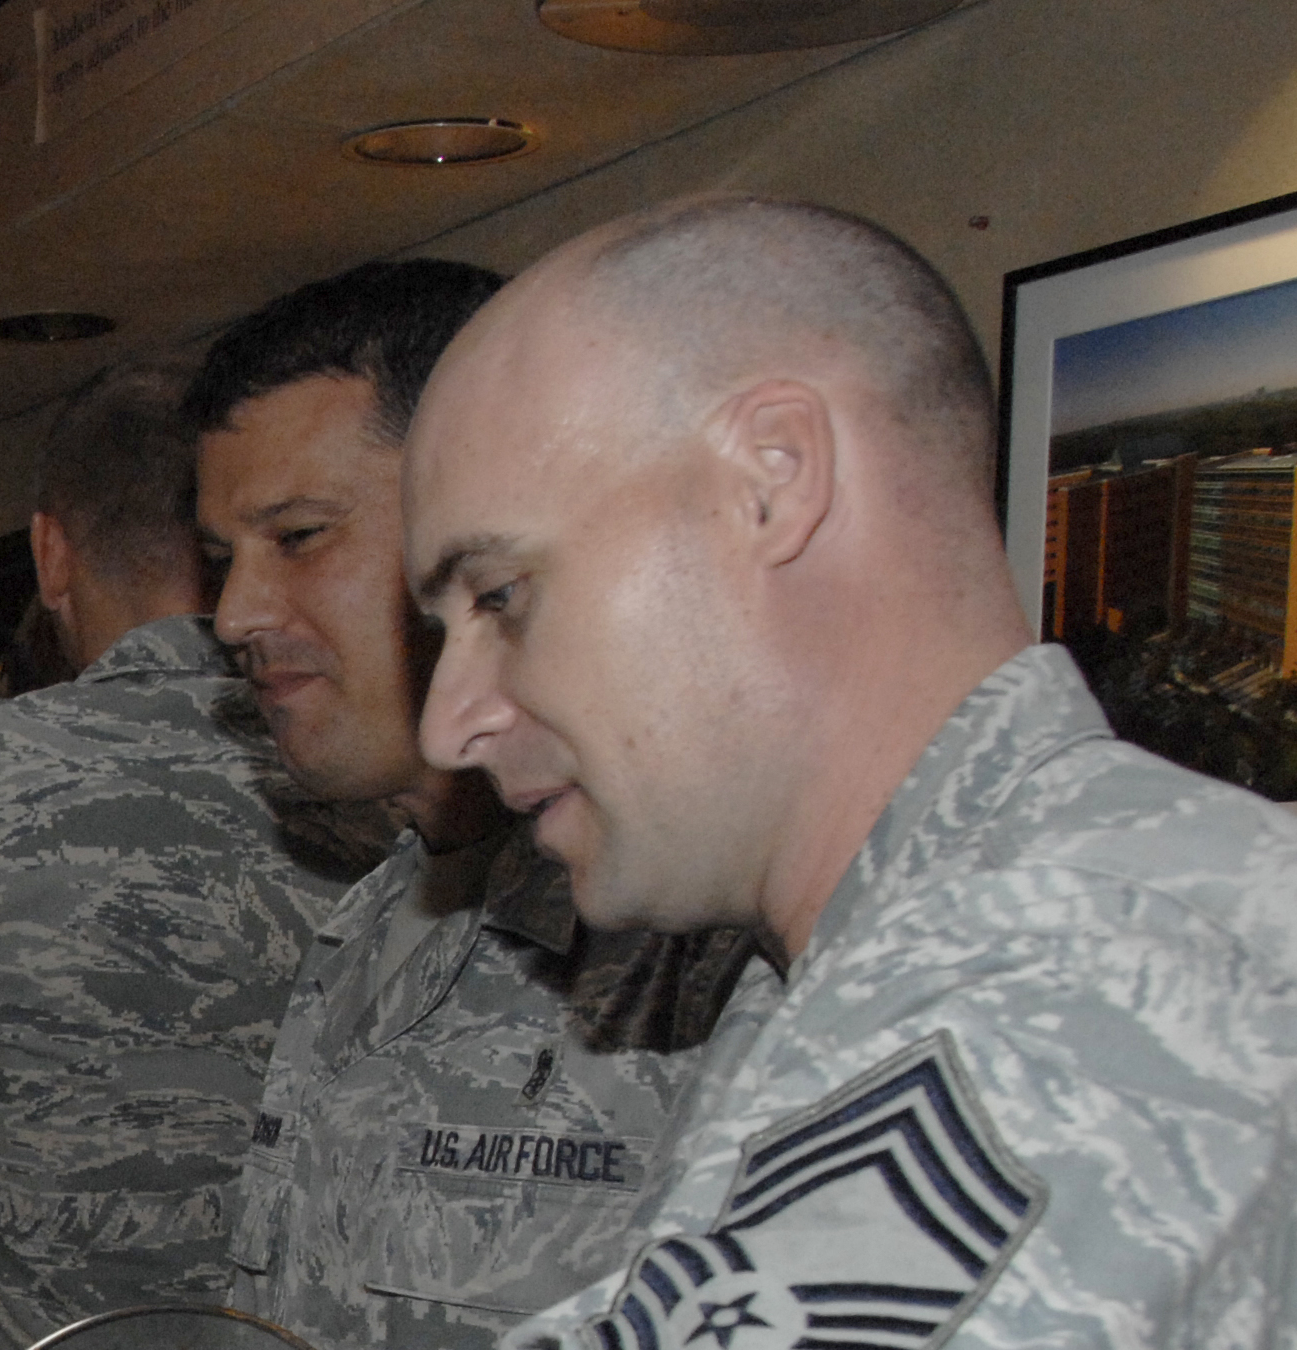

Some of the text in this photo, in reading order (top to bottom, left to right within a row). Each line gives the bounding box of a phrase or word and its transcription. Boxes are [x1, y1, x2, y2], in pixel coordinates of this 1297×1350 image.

[420, 1129, 627, 1183] U.S. AIR FORCE
